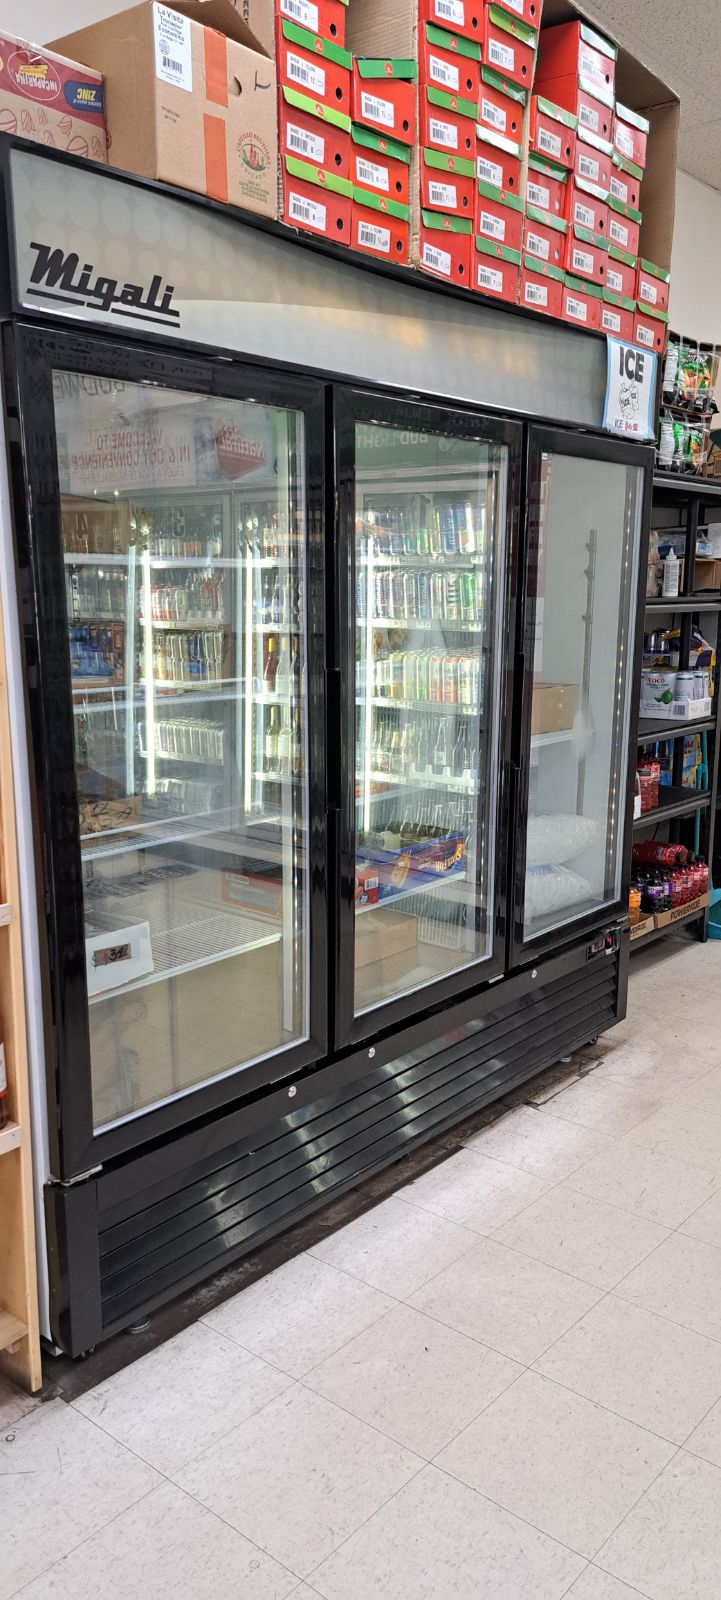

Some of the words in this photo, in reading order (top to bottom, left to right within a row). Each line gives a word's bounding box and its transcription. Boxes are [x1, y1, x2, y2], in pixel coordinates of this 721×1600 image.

[157, 6, 166, 16] La
[167, 10, 184, 25] Visita
[14, 72, 58, 92] INCAPARINA
[76, 88, 97, 101] ZINC
[30, 242, 180, 317] Migali
[619, 345, 645, 384] ICE
[670, 901, 701, 921] POWERADE
